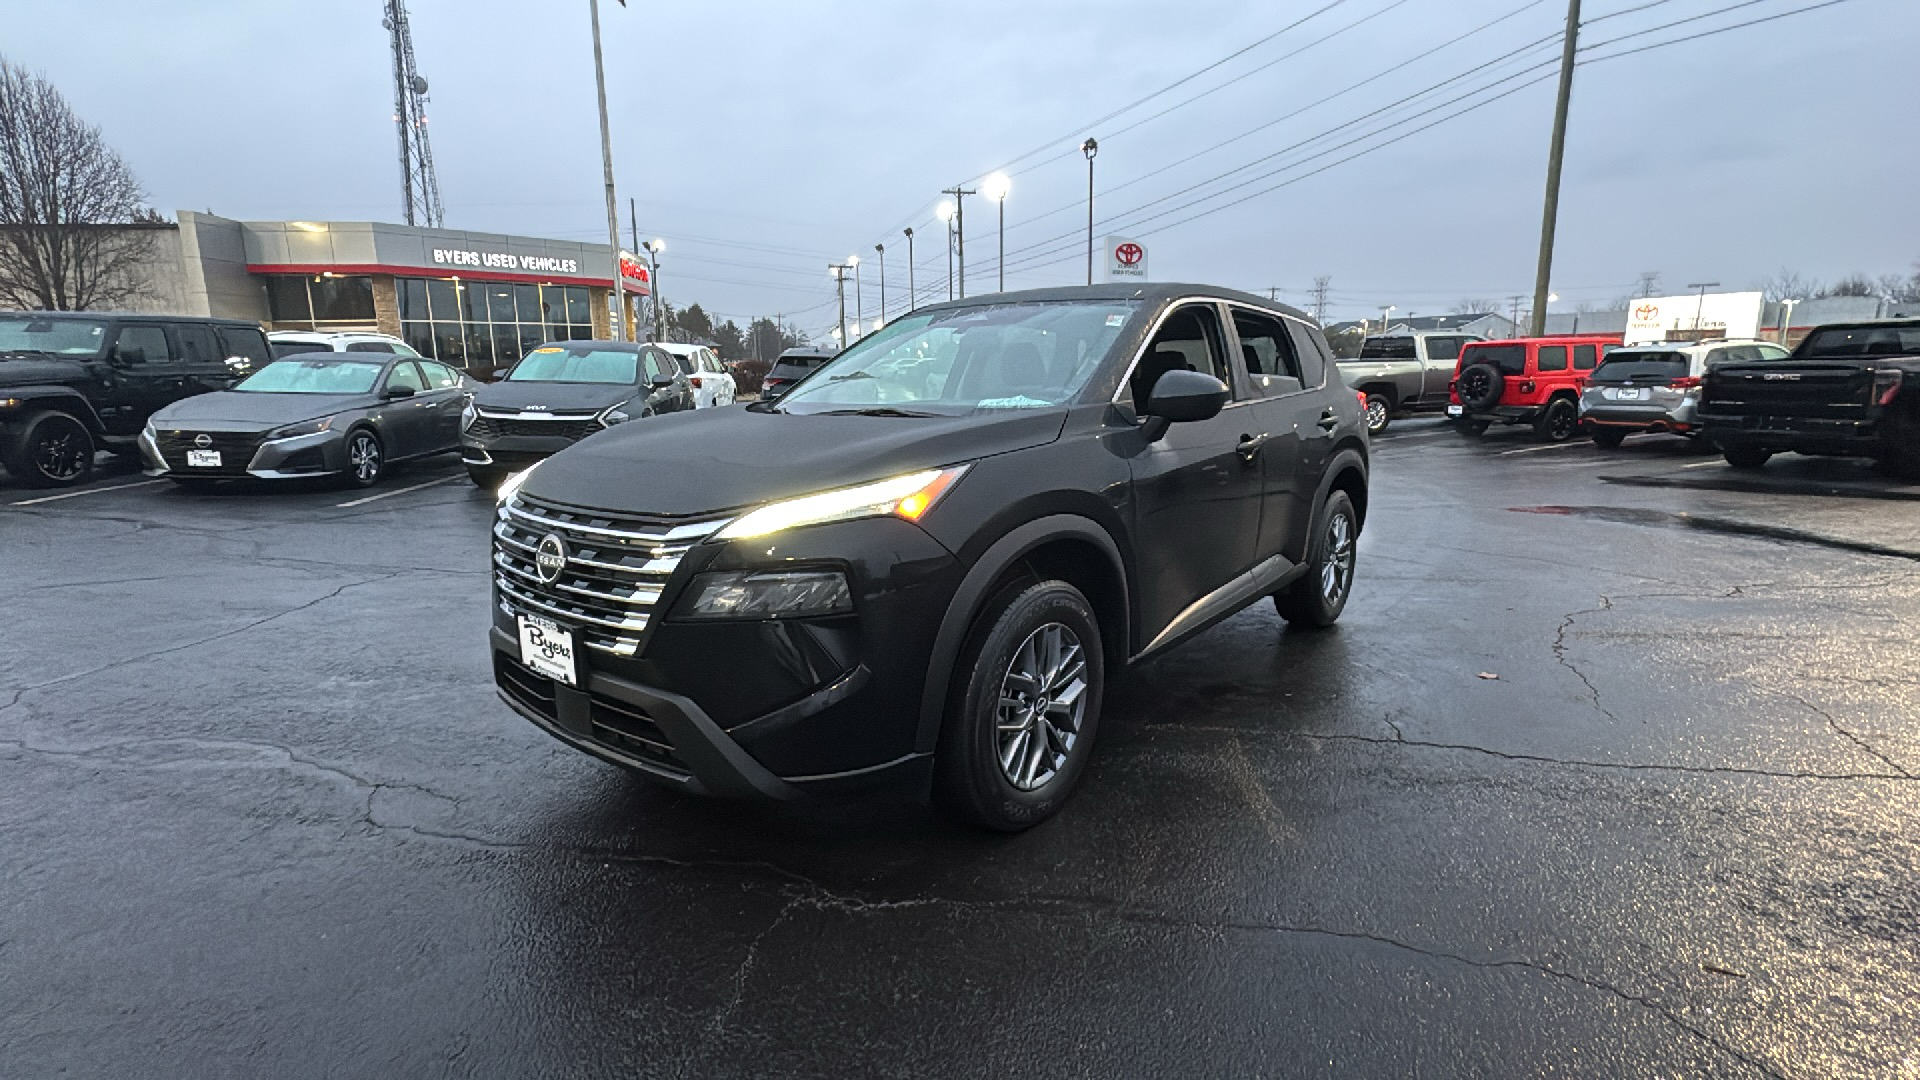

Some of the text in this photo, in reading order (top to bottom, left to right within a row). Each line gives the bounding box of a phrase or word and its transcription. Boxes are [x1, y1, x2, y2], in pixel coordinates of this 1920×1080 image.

[433, 249, 577, 273] BYERS USED VEHICLES
